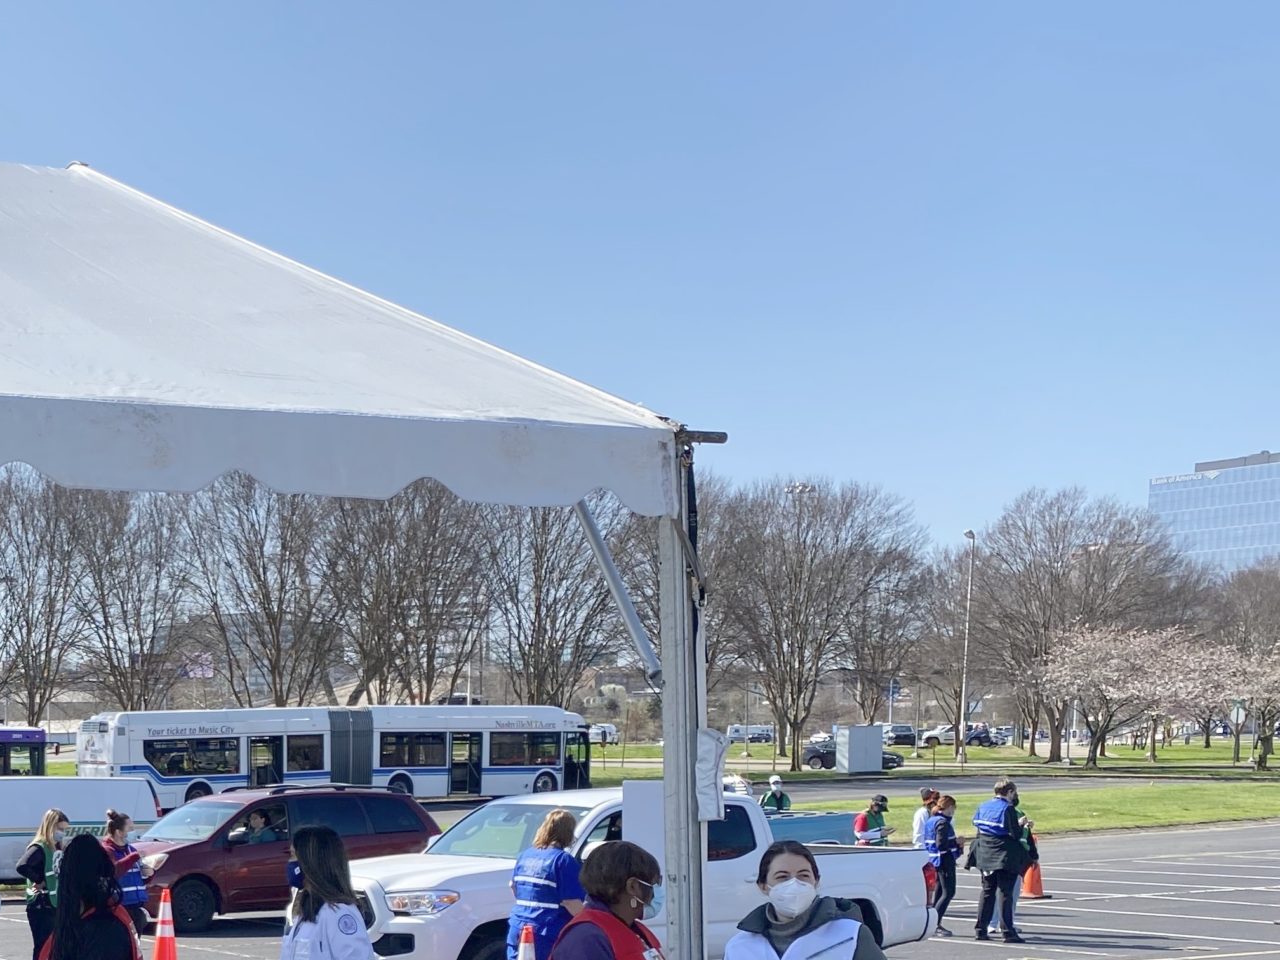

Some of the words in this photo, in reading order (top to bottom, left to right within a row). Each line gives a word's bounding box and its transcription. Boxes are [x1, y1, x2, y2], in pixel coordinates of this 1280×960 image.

[148, 727, 164, 736] Your
[167, 726, 187, 736] ticket
[199, 726, 218, 735] Music
[220, 725, 235, 734] City
[495, 720, 556, 730] NashvilleMTA.org
[64, 826, 109, 837] SHERI
